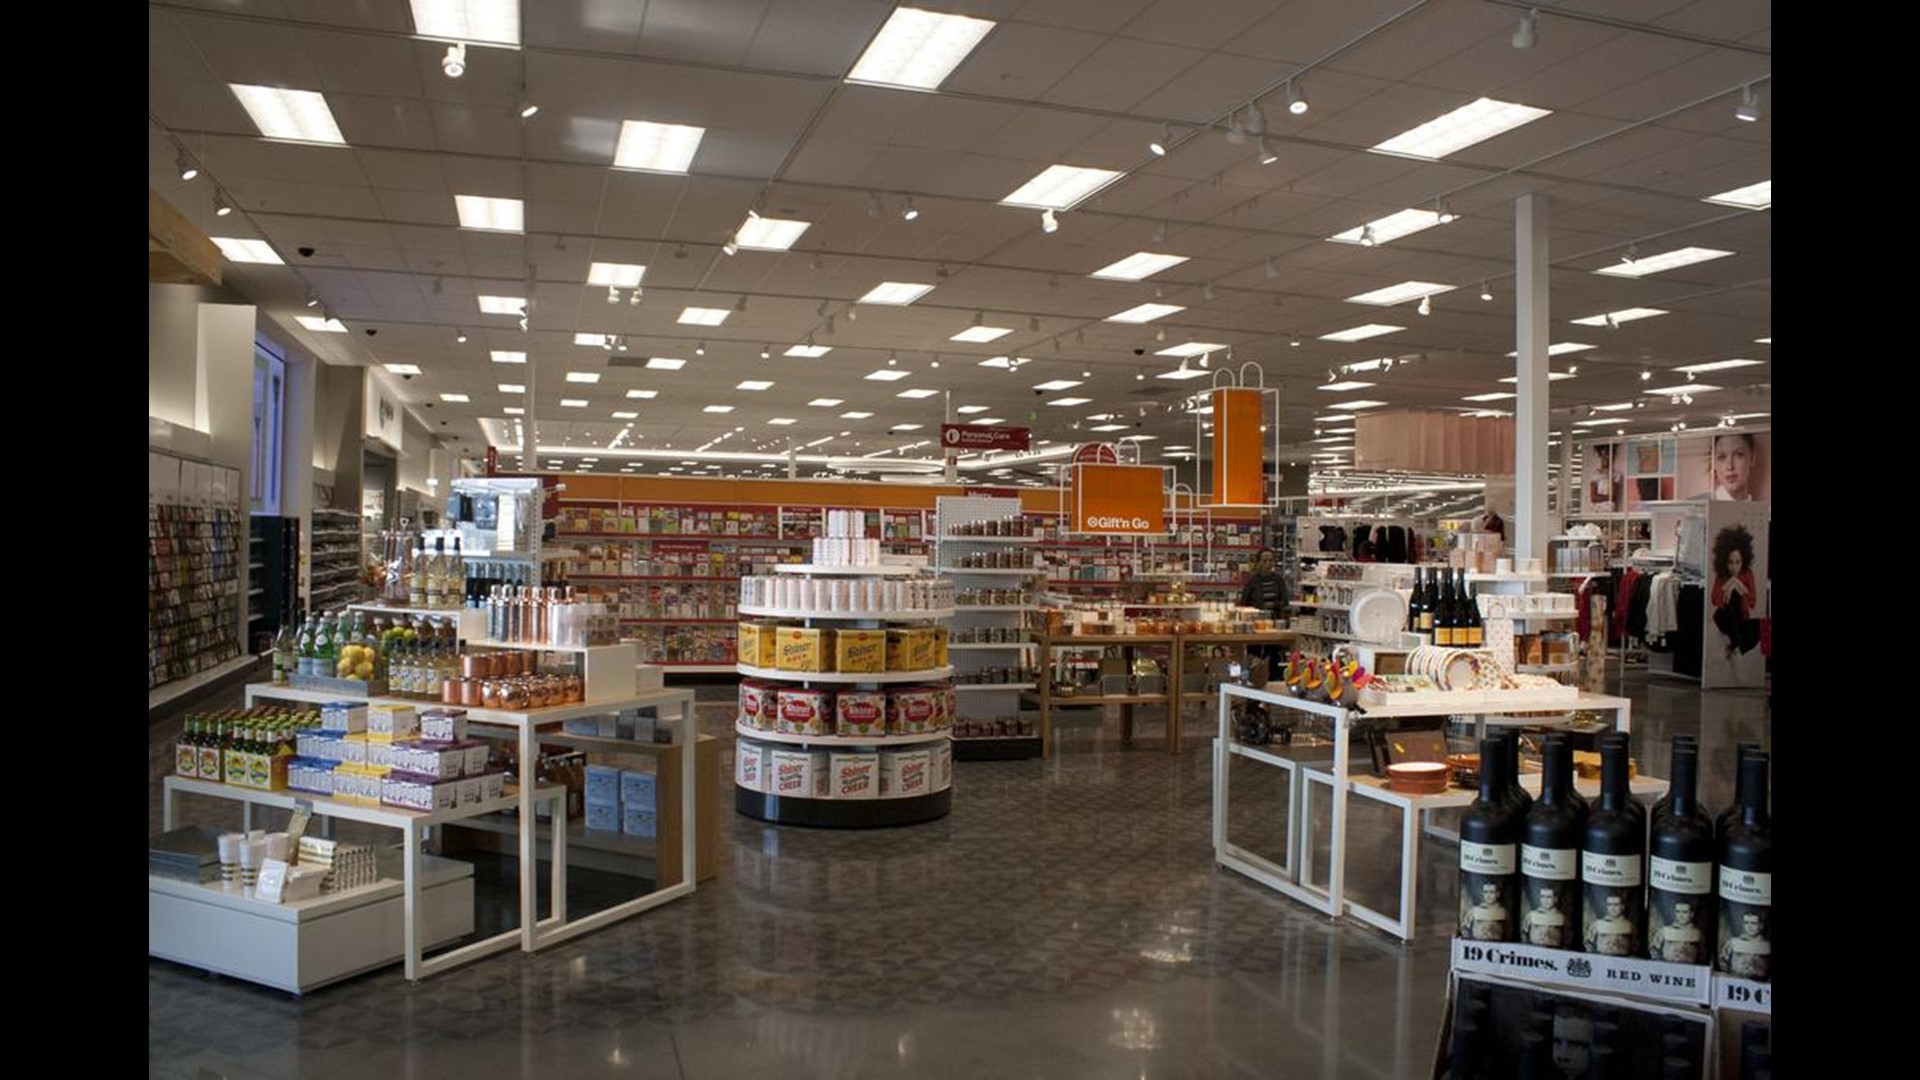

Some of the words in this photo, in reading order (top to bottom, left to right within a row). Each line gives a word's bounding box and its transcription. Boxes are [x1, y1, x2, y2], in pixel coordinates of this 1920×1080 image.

[1132, 517, 1150, 530] Go
[1463, 946, 1483, 961] 19
[1486, 946, 1558, 971] Crimes.
[1606, 968, 1642, 982] RED
[1650, 973, 1697, 988] WINE
[1727, 985, 1750, 1001] 19
